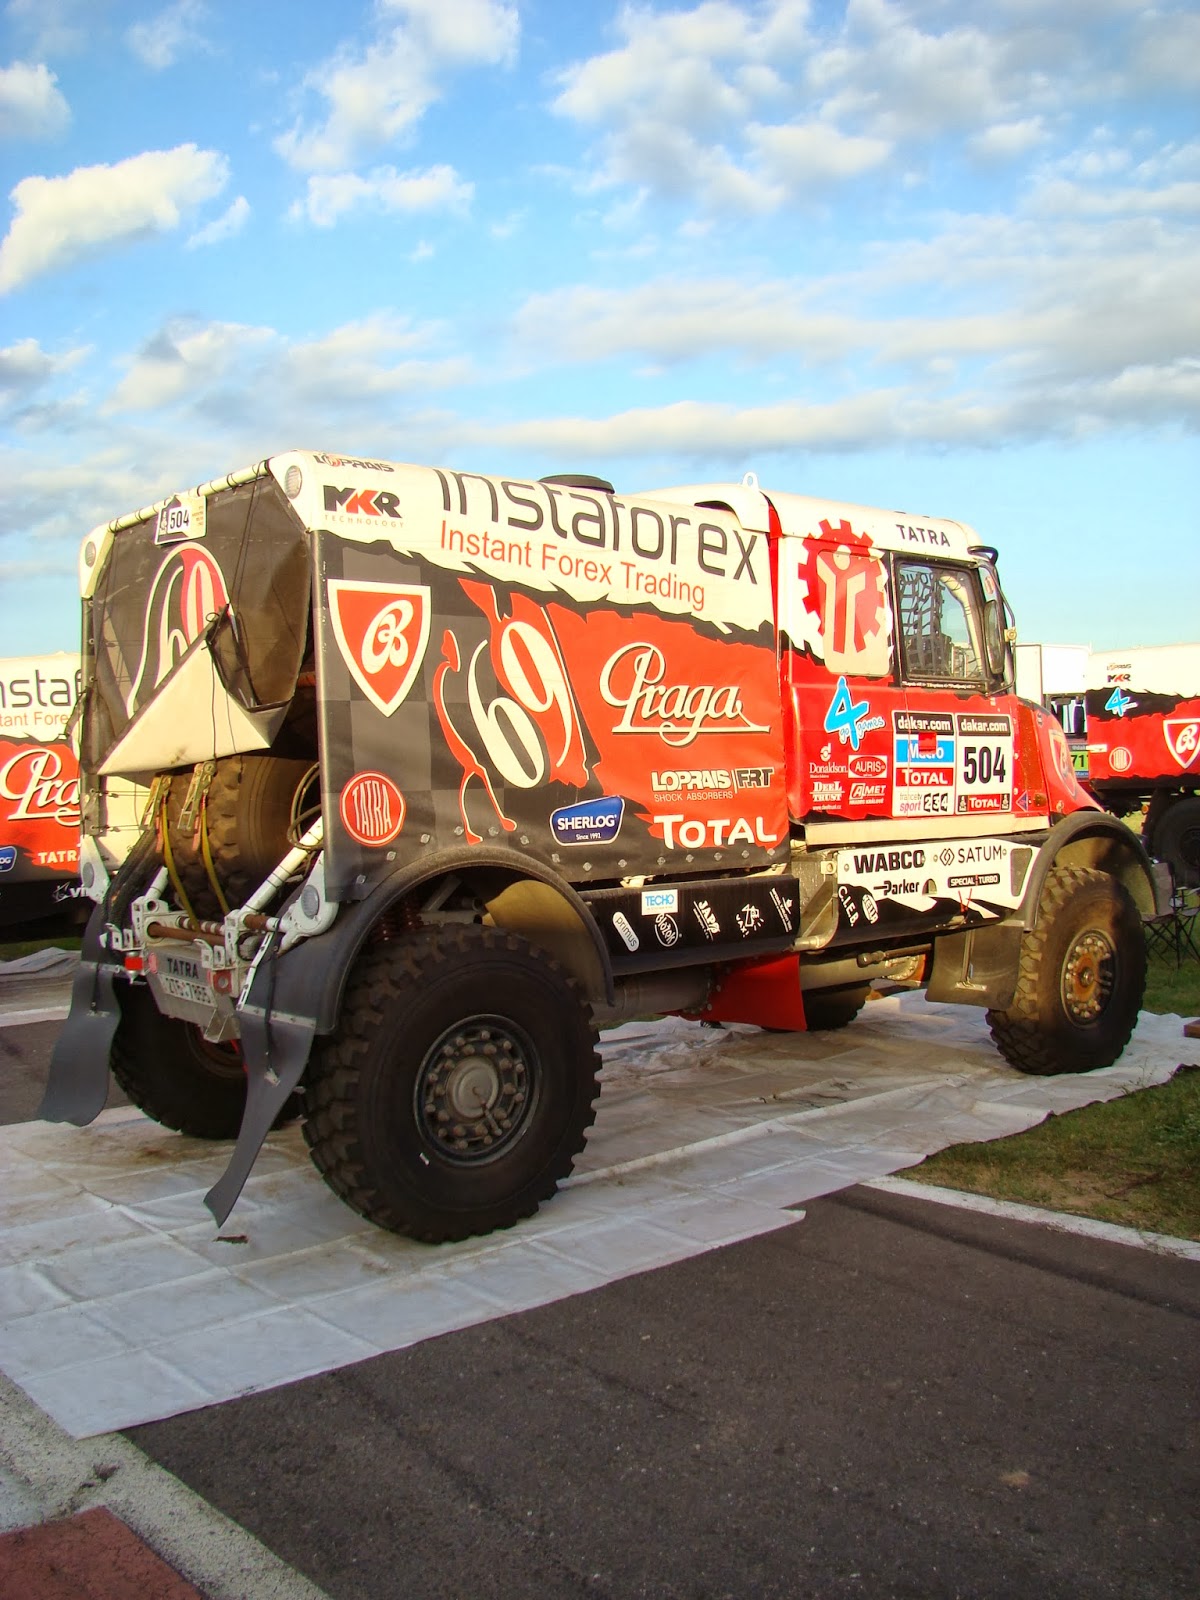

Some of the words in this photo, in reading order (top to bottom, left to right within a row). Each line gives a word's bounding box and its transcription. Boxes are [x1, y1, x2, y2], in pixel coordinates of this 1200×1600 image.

[323, 485, 402, 518] MKR
[169, 509, 190, 529] 504
[324, 515, 404, 528] TECHNOLOGY
[896, 524, 950, 547] TATRA
[441, 520, 532, 568] Instant
[541, 544, 613, 584] Forex
[620, 561, 705, 612] Trading
[599, 641, 771, 747] Praga
[857, 717, 884, 738] games
[897, 715, 951, 731] dakar.com
[960, 718, 1008, 732] dakar.com
[855, 760, 882, 773] AURIS
[963, 746, 1006, 785] 504
[651, 769, 732, 792] LOPRAIS
[901, 768, 948, 785] TOTAL
[654, 791, 683, 802] SHOCK
[686, 791, 734, 801] ABSORBERS
[968, 797, 1000, 809] TOTAL
[352, 780, 393, 837] TATRA
[557, 815, 616, 831] SHERLOG
[653, 814, 777, 849] TOTAL
[38, 849, 80, 865] TATR
[853, 849, 925, 874] WABCO
[957, 845, 1003, 864] SATUM
[883, 878, 920, 896] Parker
[950, 878, 975, 887] SPECIAL
[978, 875, 998, 884] TURBO
[645, 894, 675, 907] TECHO
[614, 915, 638, 949] primus
[168, 958, 199, 979] TATRA
